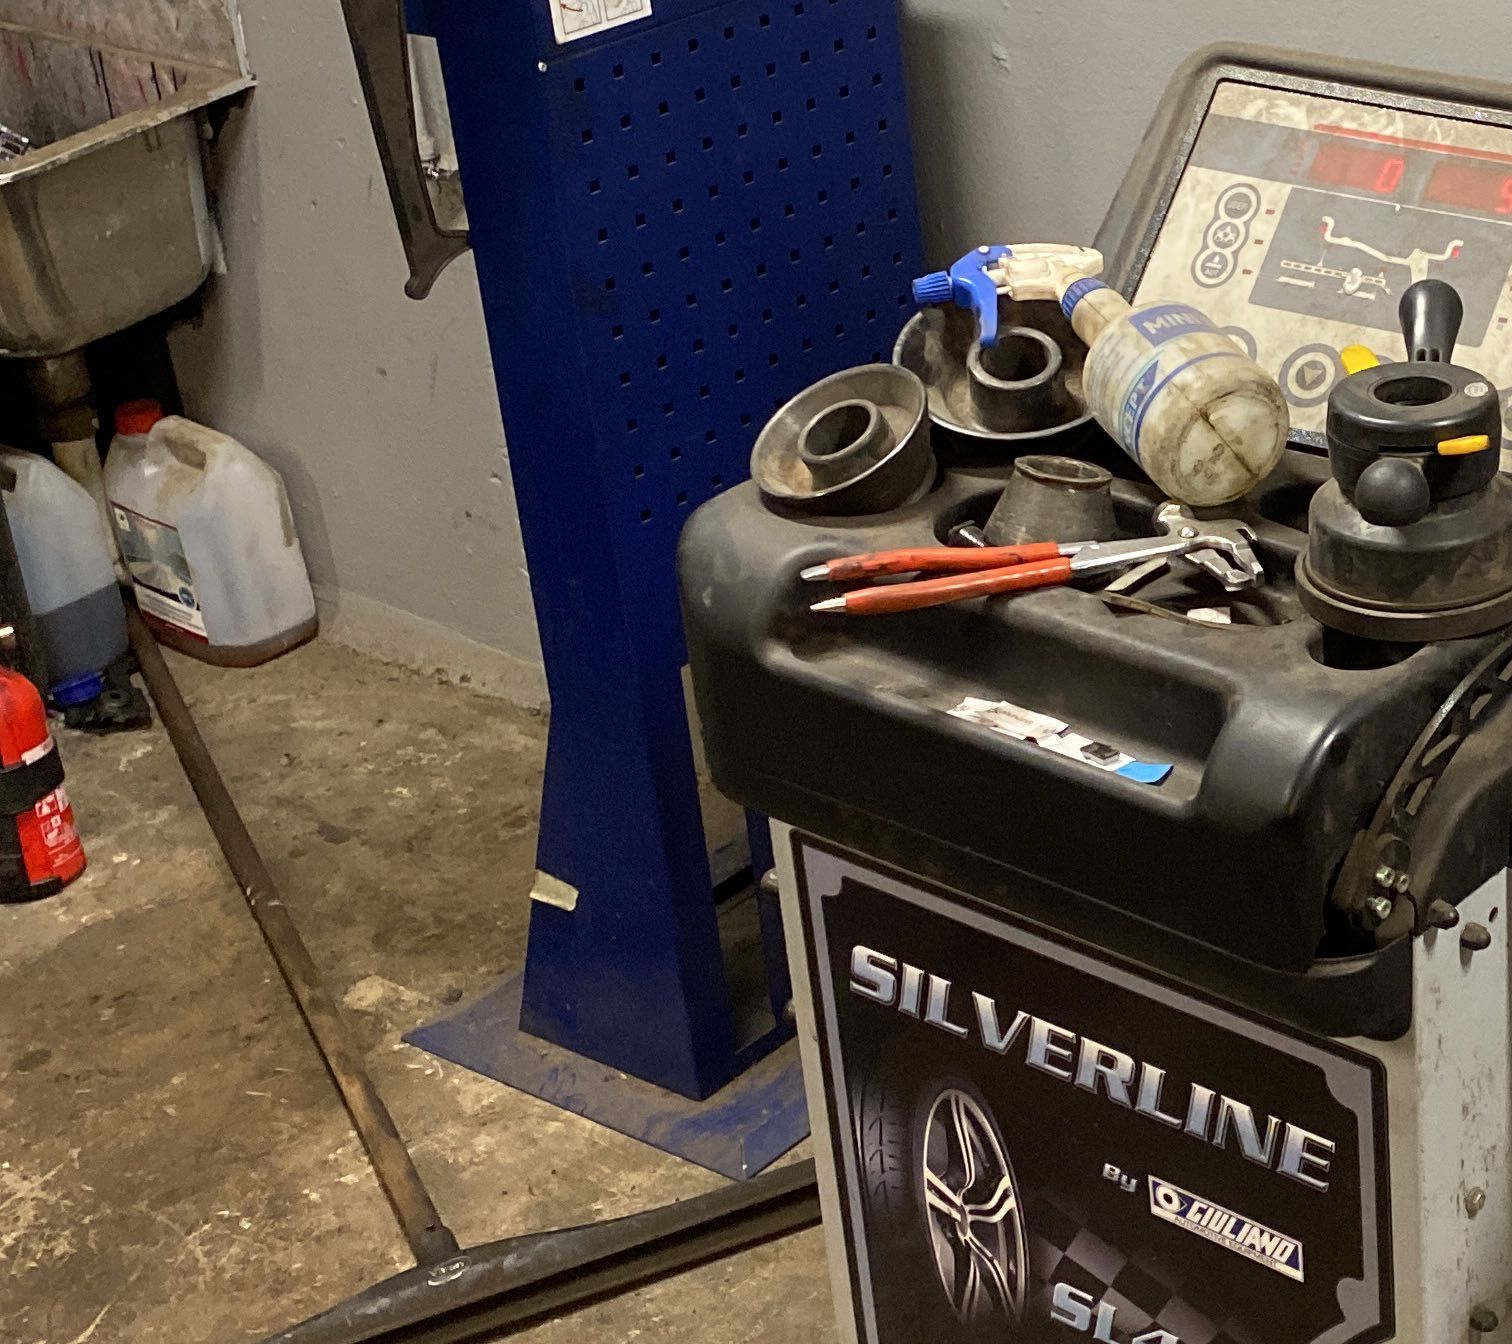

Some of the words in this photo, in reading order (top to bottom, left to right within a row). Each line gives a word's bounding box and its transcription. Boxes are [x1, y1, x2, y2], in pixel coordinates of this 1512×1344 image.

[1374, 158, 1405, 193] 0
[849, 944, 1336, 1193] SILVERLINE
[1102, 1162, 1138, 1193] By
[1185, 1202, 1296, 1264] GIULIANO
